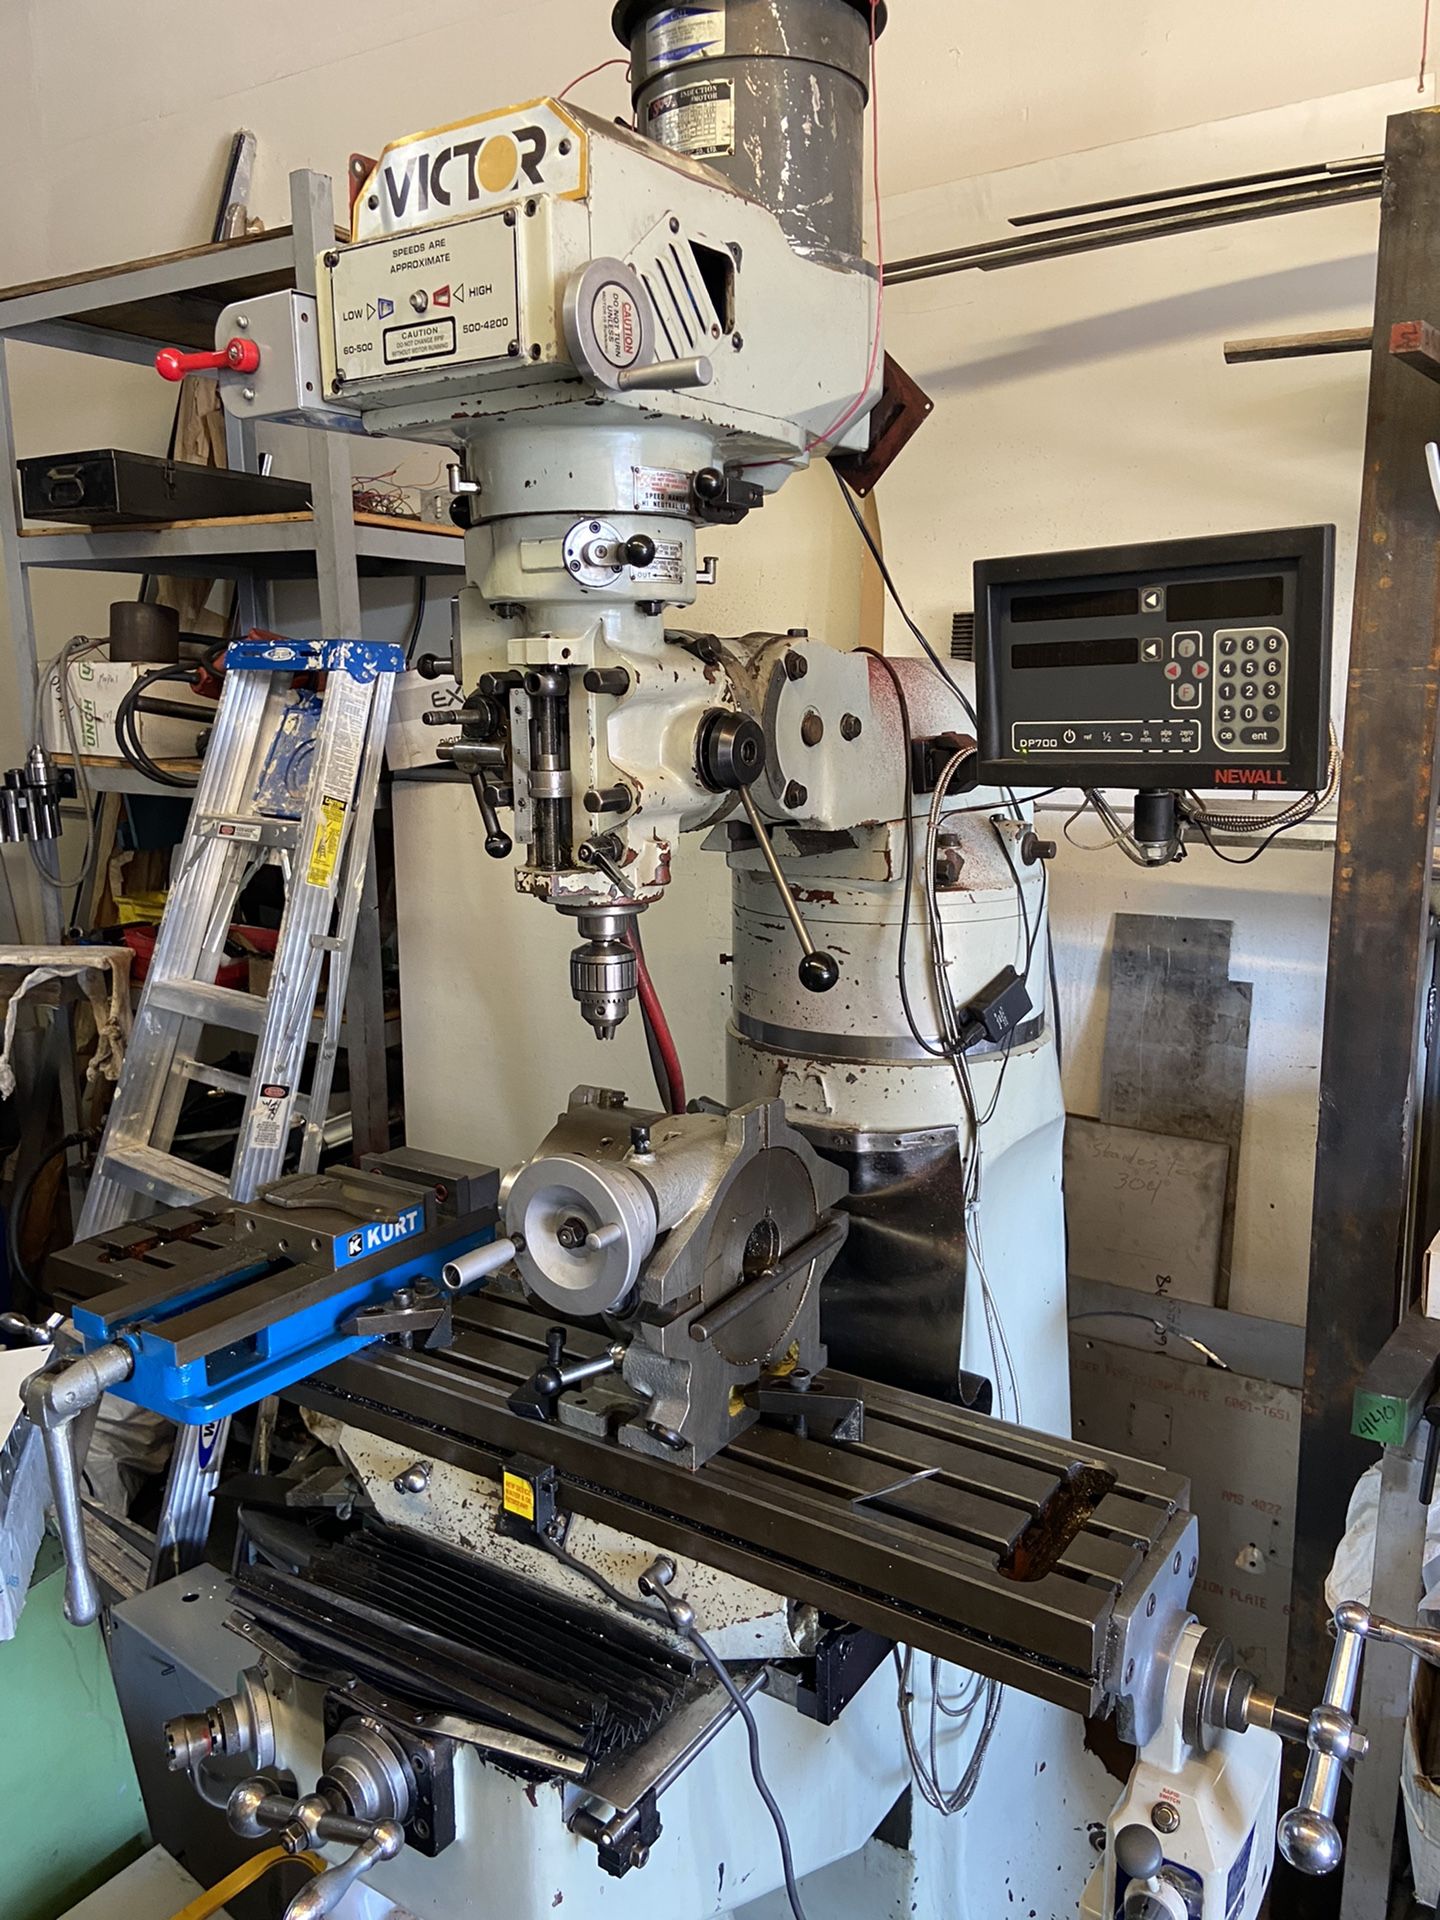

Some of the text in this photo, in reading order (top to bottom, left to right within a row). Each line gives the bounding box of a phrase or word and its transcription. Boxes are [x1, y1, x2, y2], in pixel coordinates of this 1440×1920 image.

[384, 125, 547, 218] VICTOR
[392, 238, 446, 258] SPEEDS ARE
[390, 253, 451, 274] APPROXIMATE
[469, 284, 493, 298] HIGH
[612, 293, 619, 307] DO
[342, 309, 364, 321] LOW
[462, 317, 509, 334] 500-4200
[622, 302, 634, 354] CAUTION
[401, 326, 439, 340] CAUTION
[343, 342, 373, 355] 60-500
[645, 492, 665, 500] SPEED
[653, 501, 679, 509] NEUTRAL
[1225, 638, 1277, 652] 7 8 9
[1223, 661, 1276, 674] 4 5 6
[1182, 687, 1190, 697] F
[1224, 684, 1276, 697] 1 2 3
[1245, 707, 1252, 719] 0
[1220, 730, 1267, 740] ce ent
[1019, 738, 1058, 748] DP700
[1215, 769, 1288, 784] NEWALL
[367, 1210, 418, 1249] KURT
[1224, 1397, 1291, 1421] 6061-T651
[1230, 1588, 1268, 1609] PLATE
